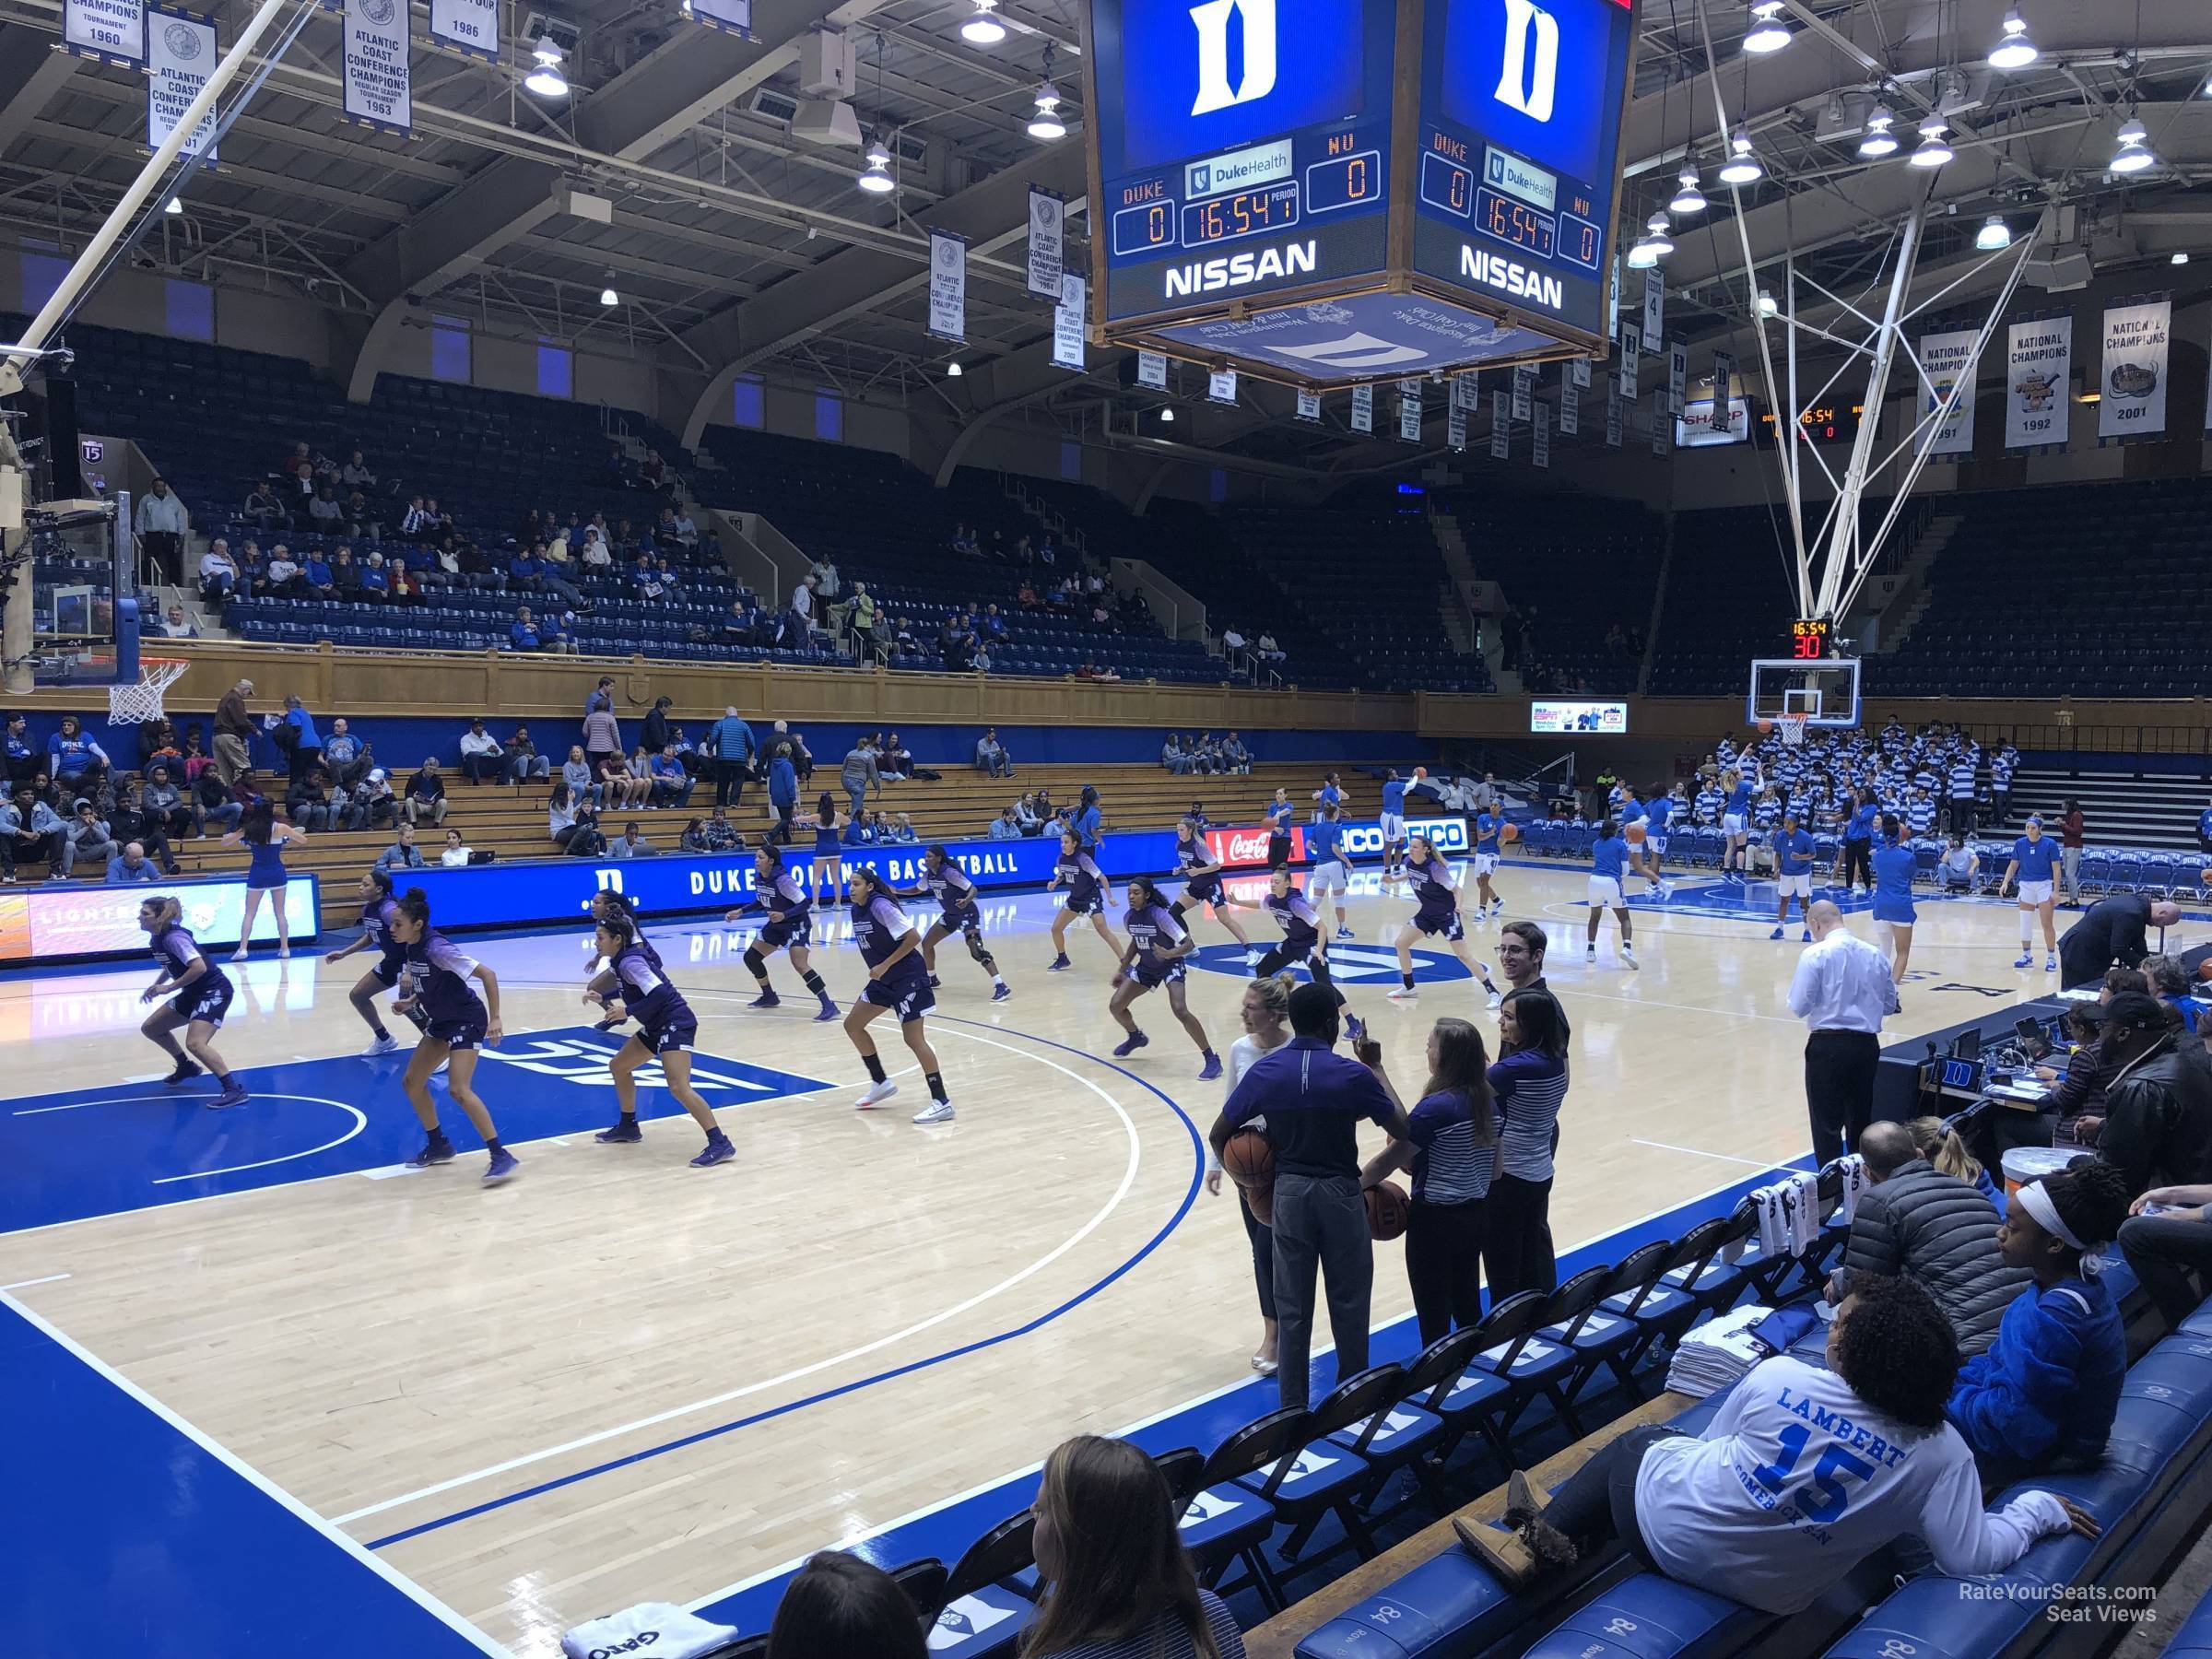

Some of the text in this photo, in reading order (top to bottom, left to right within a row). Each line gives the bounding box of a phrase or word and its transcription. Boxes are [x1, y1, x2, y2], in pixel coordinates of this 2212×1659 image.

[83, 13, 127, 30] TOURNAMENT
[453, 19, 479, 38] 1986
[89, 28, 121, 45] 1960
[355, 29, 399, 52] ATLANTIC
[362, 44, 393, 63] COAST
[1189, 0, 1277, 116] D
[160, 67, 206, 86] ATLANTIC
[347, 53, 409, 79] CONFERENCE
[168, 81, 200, 96] COAST
[350, 67, 406, 91] CHAMPIONS
[152, 89, 215, 113] CONFERE
[366, 100, 392, 116] 1963
[155, 102, 213, 125] CHAMNS
[1328, 133, 1355, 156] NU
[1433, 132, 1467, 162] DUKE
[1215, 152, 1287, 183] DukeHealth
[1347, 159, 1366, 198] 0
[1123, 180, 1164, 205] DUKE
[1271, 187, 1297, 202] PERIOD
[1450, 170, 1465, 209] 0
[1507, 167, 1554, 201] DukeHealth
[1148, 206, 1165, 241] 0
[1199, 193, 1269, 239] 16:54
[1488, 197, 1537, 246] 16:54
[1038, 241, 1054, 253] COAST
[1581, 227, 1594, 262] 0
[1165, 240, 1316, 298] NISSAN
[1461, 243, 1562, 310] NISSAN
[2017, 333, 2063, 349] NATIONAL
[1927, 346, 1971, 360] NATIONAL
[2011, 346, 2068, 364] CHAMPIONS
[1922, 359, 1974, 373] CHAMPIOS
[2022, 418, 2052, 431] 1992
[2116, 406, 2147, 420] 2001
[84, 446, 101, 461] 15
[1794, 622, 1827, 636] 16:54
[1794, 635, 1820, 659] 30
[690, 867, 757, 896] DUKE
[889, 852, 1019, 882] BASTBALL
[1942, 1060, 1972, 1087] D
[1776, 1386, 1906, 1469] LAMBERT
[1752, 1422, 1877, 1523] 15
[1370, 1605, 1402, 1625] 84
[1603, 1618, 1639, 1638] 84
